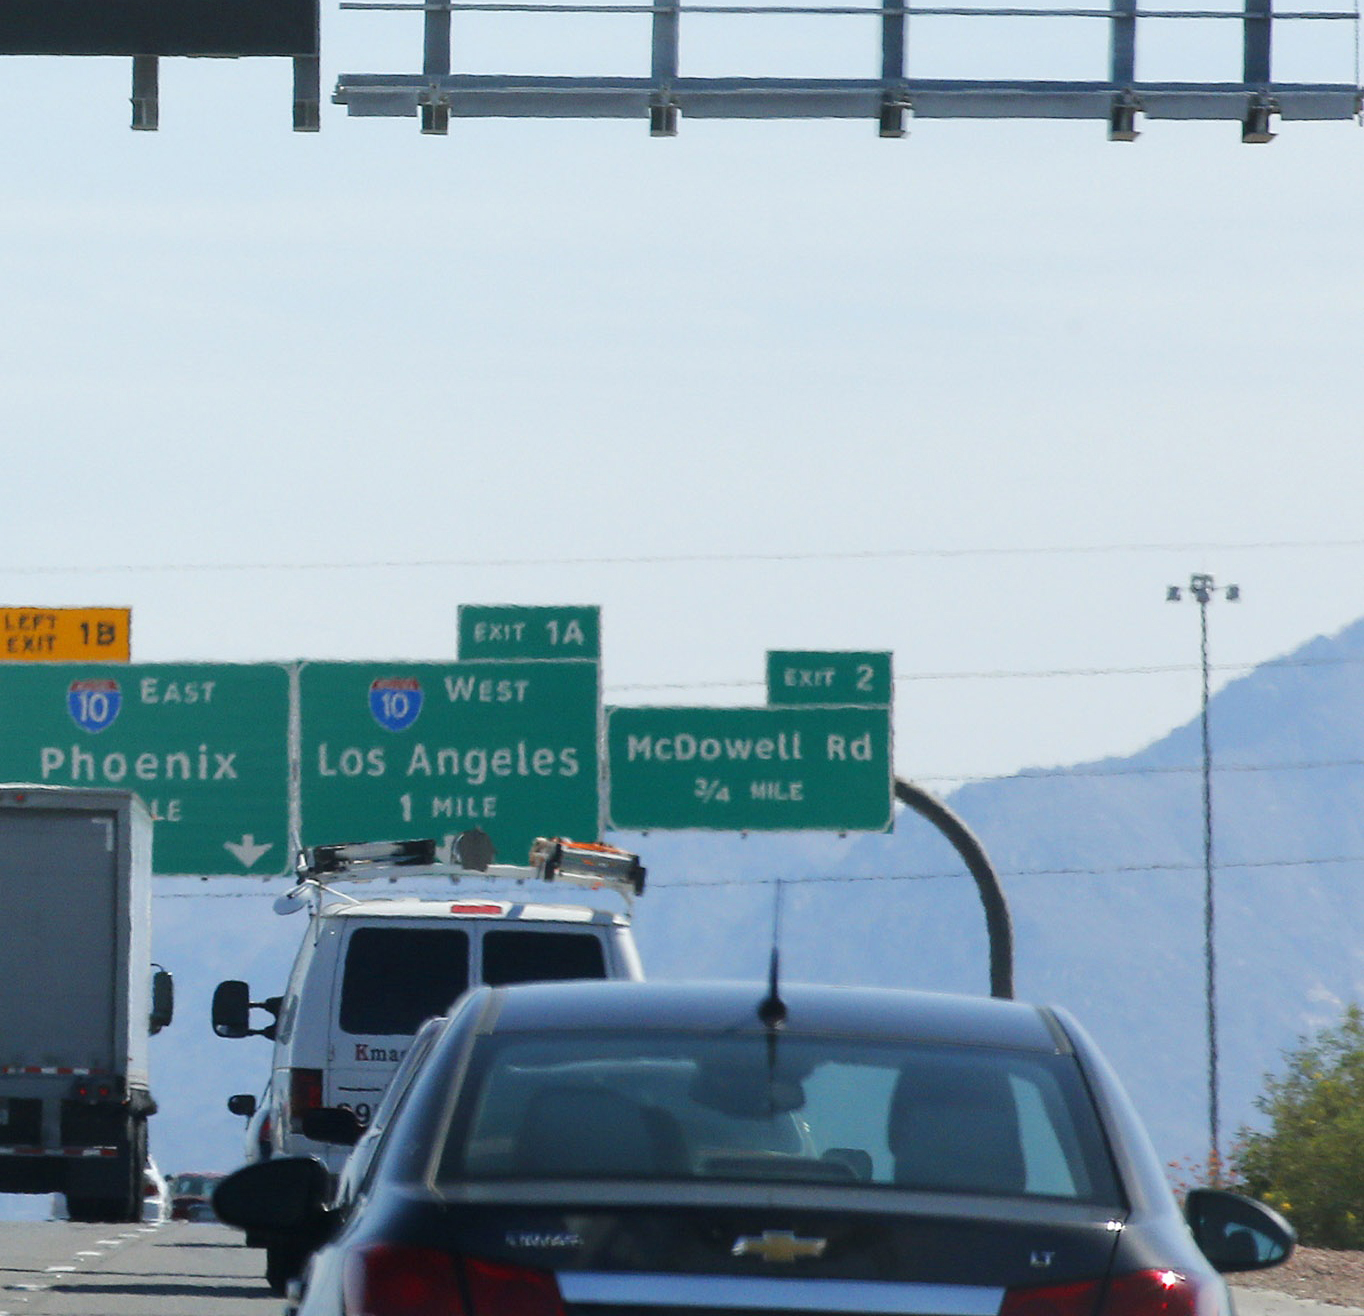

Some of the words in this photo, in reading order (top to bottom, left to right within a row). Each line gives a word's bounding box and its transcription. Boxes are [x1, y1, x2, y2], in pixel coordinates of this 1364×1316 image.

[4, 613, 56, 632] LEFT
[80, 621, 116, 646] 1B
[473, 622, 526, 642] EXIT
[546, 619, 584, 645] 1A
[6, 635, 56, 654] EXIT
[140, 677, 216, 704] EAST
[444, 675, 529, 702] WEST
[783, 667, 835, 687] EXIT
[855, 663, 875, 692] 2
[79, 691, 108, 722] 10
[382, 691, 409, 719] 10
[627, 732, 803, 761] McDowell
[826, 732, 873, 761] Rd
[39, 744, 239, 782] Phoenix
[317, 742, 386, 777] Los
[406, 741, 579, 785] Angeles
[749, 780, 804, 801] MILE
[150, 798, 182, 822] LE
[400, 793, 412, 822] 1
[432, 796, 497, 818] MILE
